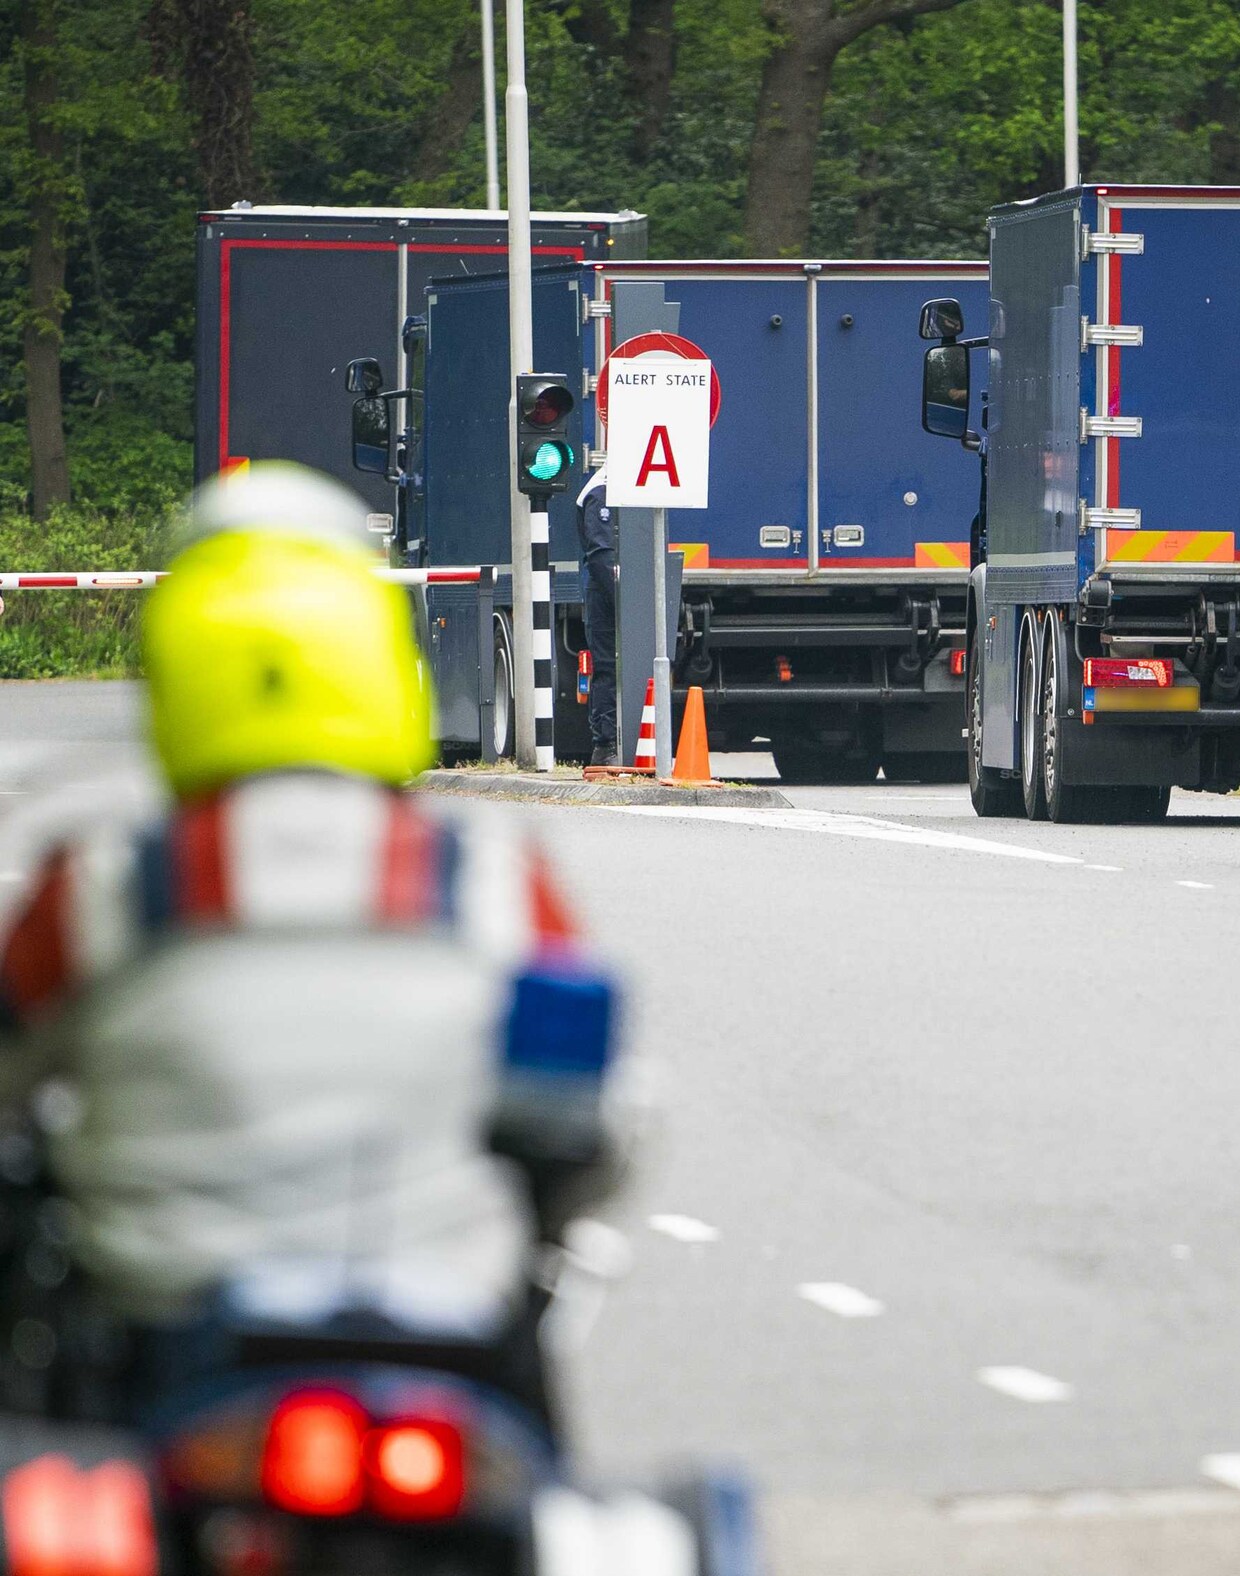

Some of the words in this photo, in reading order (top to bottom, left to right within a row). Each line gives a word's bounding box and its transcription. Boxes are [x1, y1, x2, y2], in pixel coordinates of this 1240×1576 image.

[614, 373, 657, 386] ALERT
[665, 374, 706, 387] STATE
[635, 425, 681, 488] A
[999, 769, 1022, 779] SC
